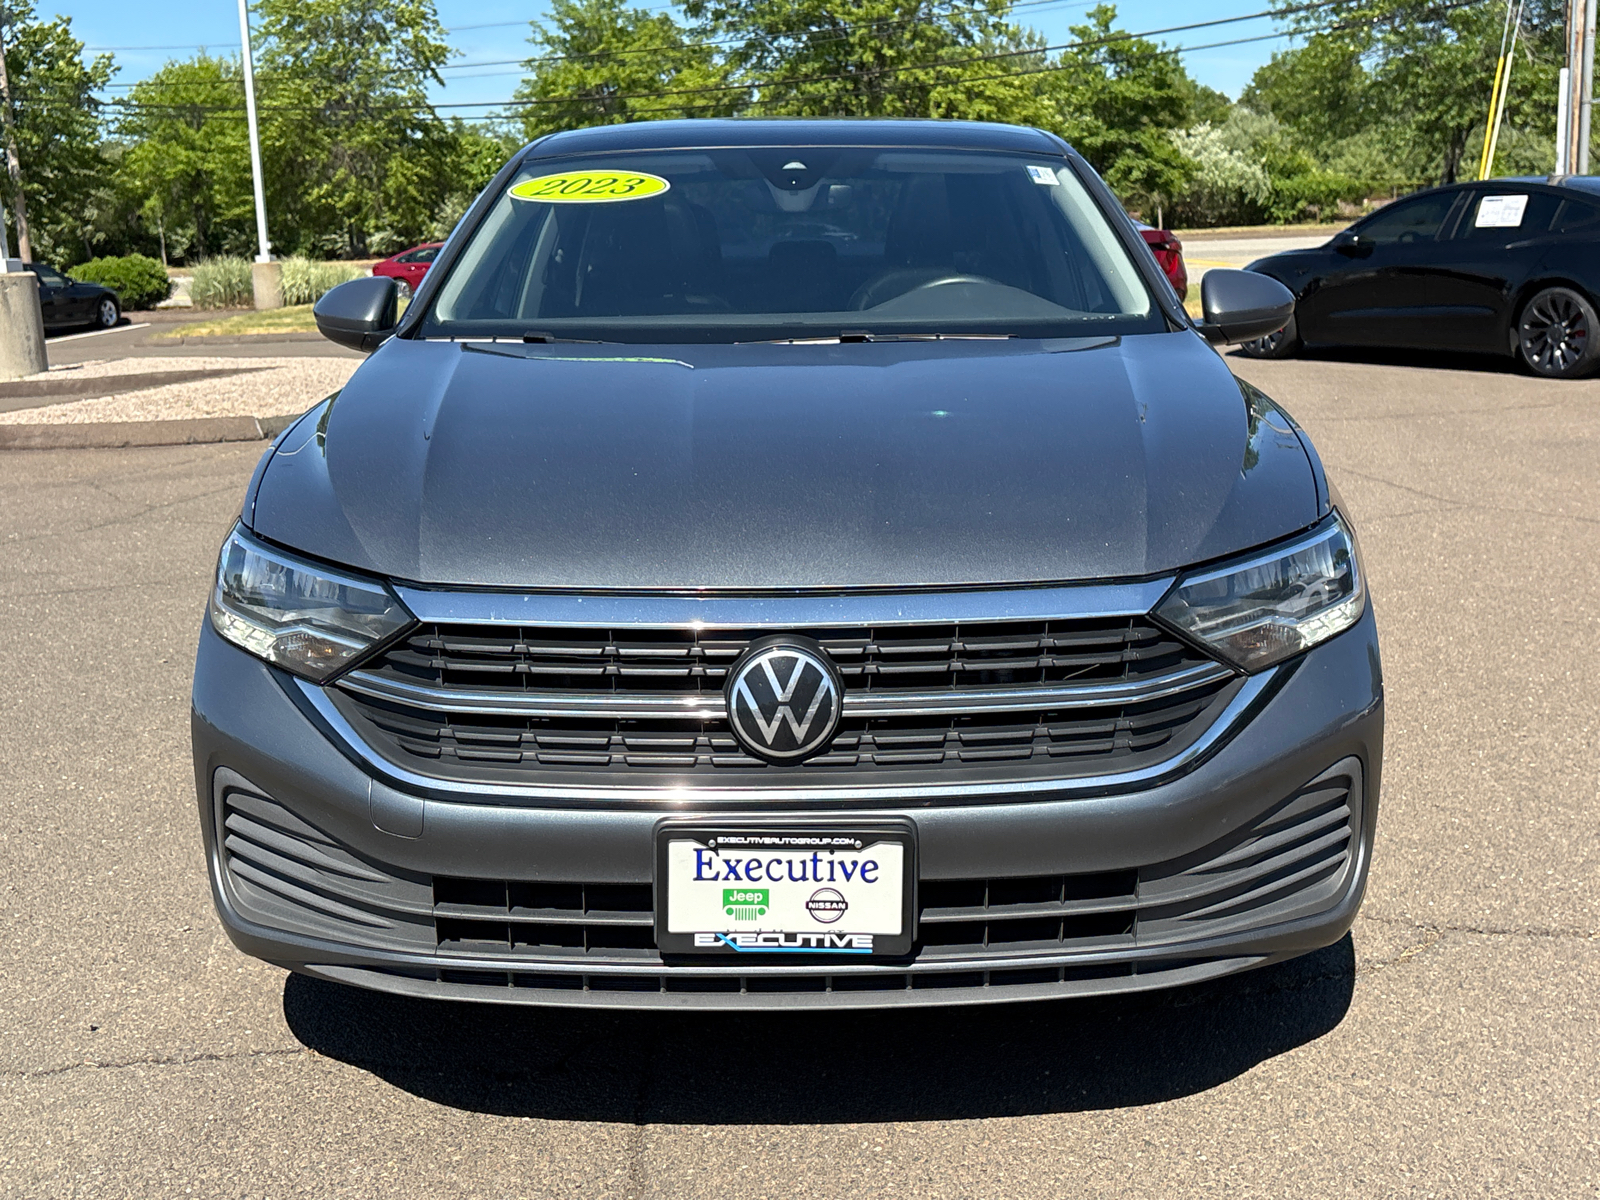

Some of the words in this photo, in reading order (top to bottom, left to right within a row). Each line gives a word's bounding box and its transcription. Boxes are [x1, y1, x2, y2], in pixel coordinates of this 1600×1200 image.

[530, 177, 646, 196] 2023
[716, 836, 855, 845] EXECUTIVEAUTOGROUP.COM
[692, 848, 879, 883] Executive
[729, 890, 763, 904] Jeep
[808, 902, 846, 910] NISSAN
[694, 933, 873, 948] EXECUTIVE
